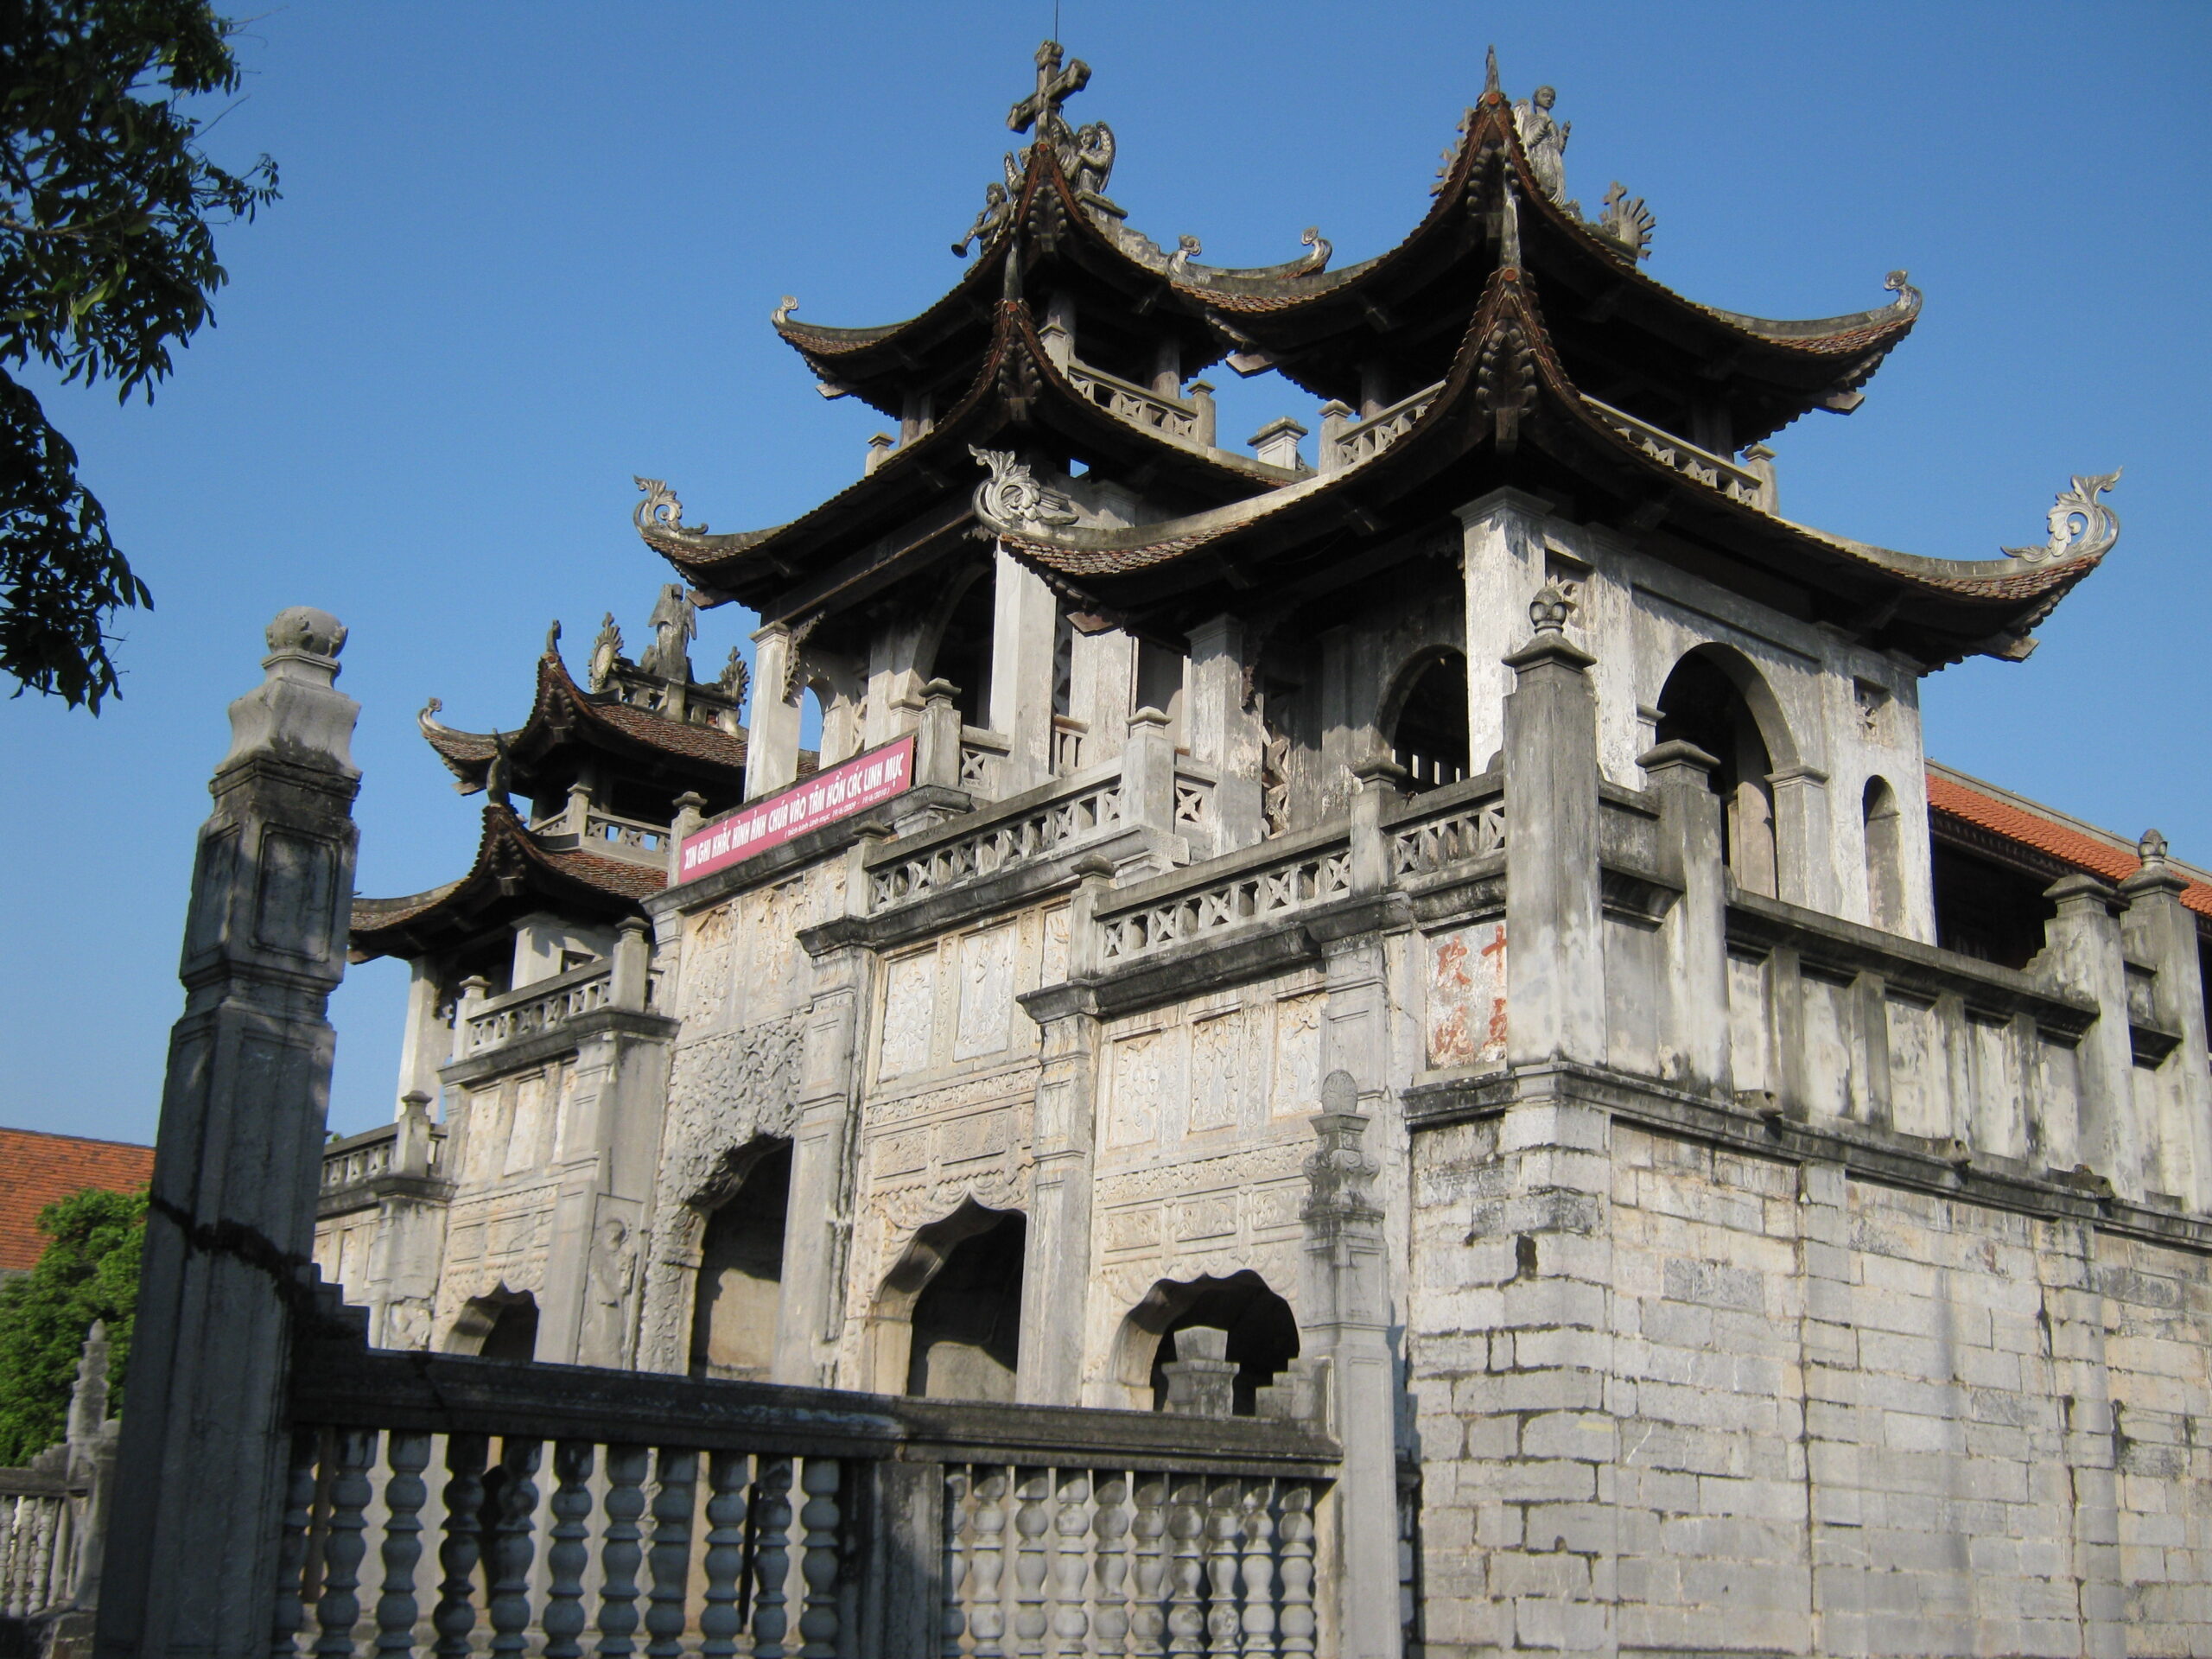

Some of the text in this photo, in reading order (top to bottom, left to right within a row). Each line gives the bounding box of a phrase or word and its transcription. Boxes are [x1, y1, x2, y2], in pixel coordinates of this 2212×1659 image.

[684, 844, 697, 871] XIN
[697, 838, 711, 864] GHI
[731, 819, 751, 850] HÌNH
[750, 809, 767, 842] ẢNH
[768, 799, 788, 833] CHÚA
[790, 792, 806, 823] VÀO
[808, 784, 825, 817] TÂM
[826, 771, 847, 809] HỒN
[847, 765, 863, 799] CÁC
[863, 761, 883, 791] LINH
[885, 752, 905, 788] MỤC
